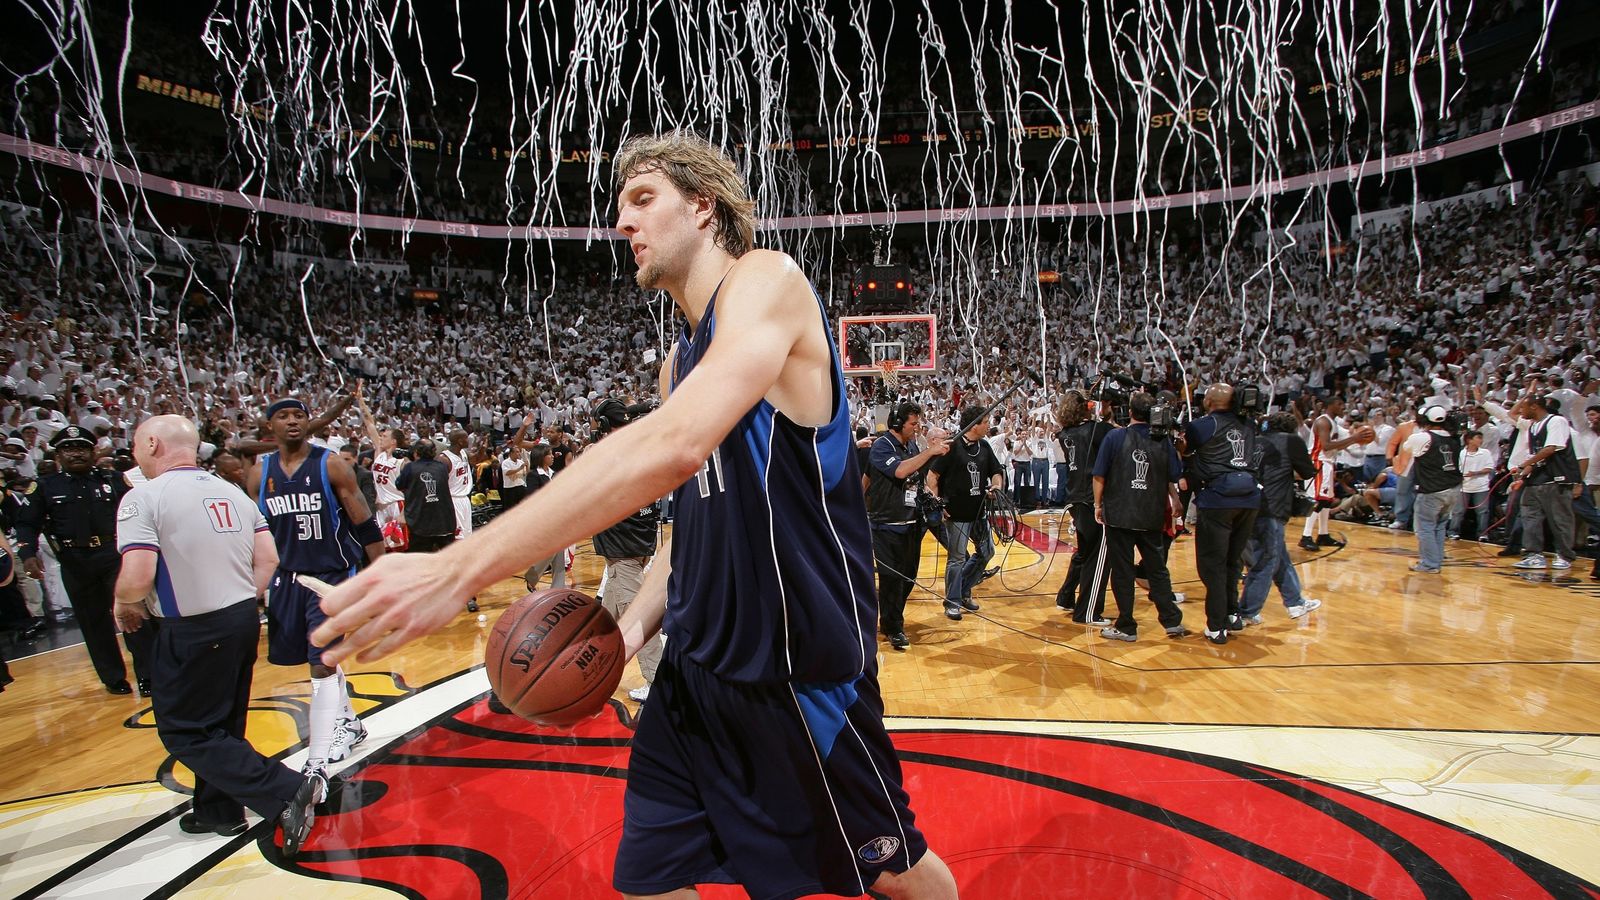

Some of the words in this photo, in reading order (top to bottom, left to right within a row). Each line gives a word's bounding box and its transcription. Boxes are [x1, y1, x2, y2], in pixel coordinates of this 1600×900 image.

[136, 73, 222, 110] MIAMI
[893, 135, 910, 144] 100
[1010, 123, 1101, 141] OFFENSVE
[795, 140, 812, 151] 101
[189, 188, 224, 203] LET'S
[324, 211, 353, 224] LET'S
[440, 222, 466, 235] LET'S
[376, 474, 389, 485] 55
[1131, 482, 1148, 490] 2006
[266, 492, 322, 517] DALLAS
[209, 502, 233, 529] 17
[296, 513, 323, 541] 31
[509, 593, 589, 674] SPALDING
[575, 644, 599, 671] NBA
